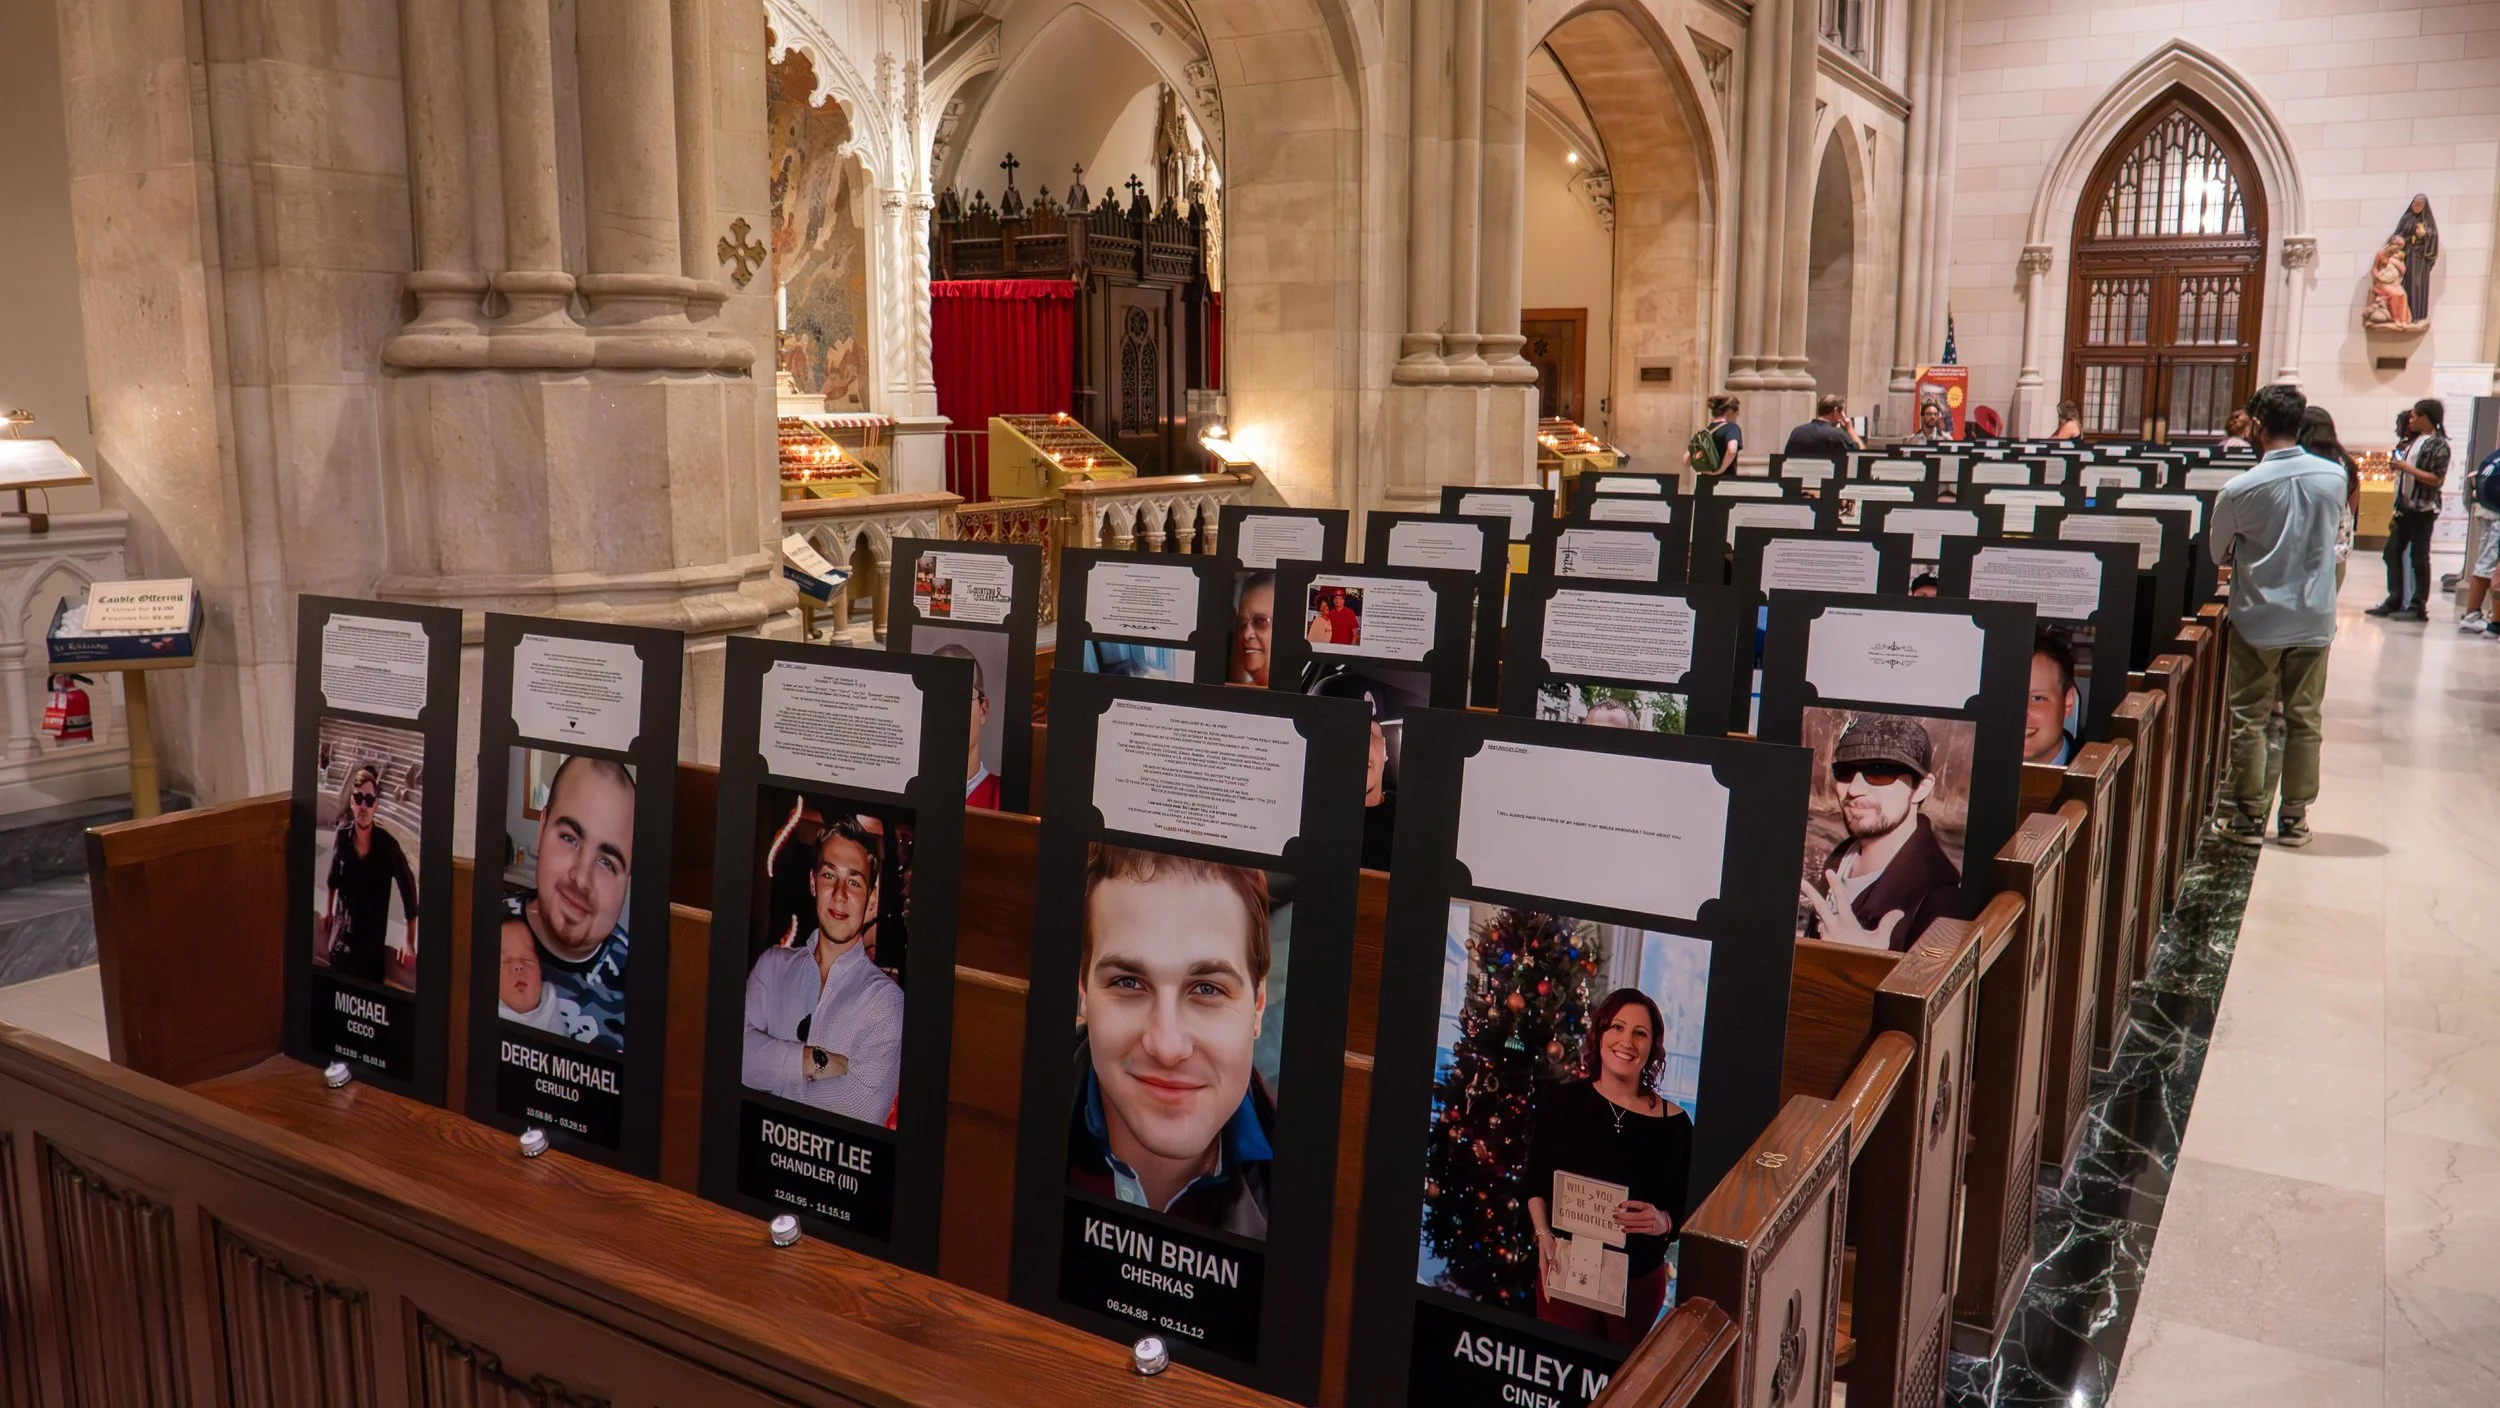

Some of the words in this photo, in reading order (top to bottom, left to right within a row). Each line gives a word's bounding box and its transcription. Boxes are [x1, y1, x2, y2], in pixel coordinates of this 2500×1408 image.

[98, 595, 134, 604] Candle
[138, 594, 184, 603] Offering
[335, 991, 390, 1026] MICHAEL
[347, 1019, 375, 1039] CECCO
[501, 1040, 549, 1075] DEREK
[552, 1056, 620, 1095] MICHAEL
[535, 1078, 579, 1102] CERULLO
[761, 1118, 835, 1162] ROBERT
[838, 1142, 872, 1174] LEE
[770, 1152, 835, 1185] CHANDLER
[837, 1173, 859, 1195] (III)
[774, 1188, 808, 1207] 12.01.95
[816, 1202, 851, 1221] 11.15.18
[1566, 1181, 1585, 1194] WILL
[1595, 1189, 1613, 1203] YOU
[1576, 1198, 1586, 1209] BE
[1593, 1203, 1607, 1215] MY
[1084, 1217, 1153, 1263] KEVIN
[1160, 1240, 1239, 1289] BRIAN
[1121, 1263, 1194, 1300] CHERKAS
[1106, 1299, 1149, 1321] 06.24.88
[1160, 1316, 1205, 1340] 02.11.12
[1453, 1331, 1574, 1391] ASHLEY
